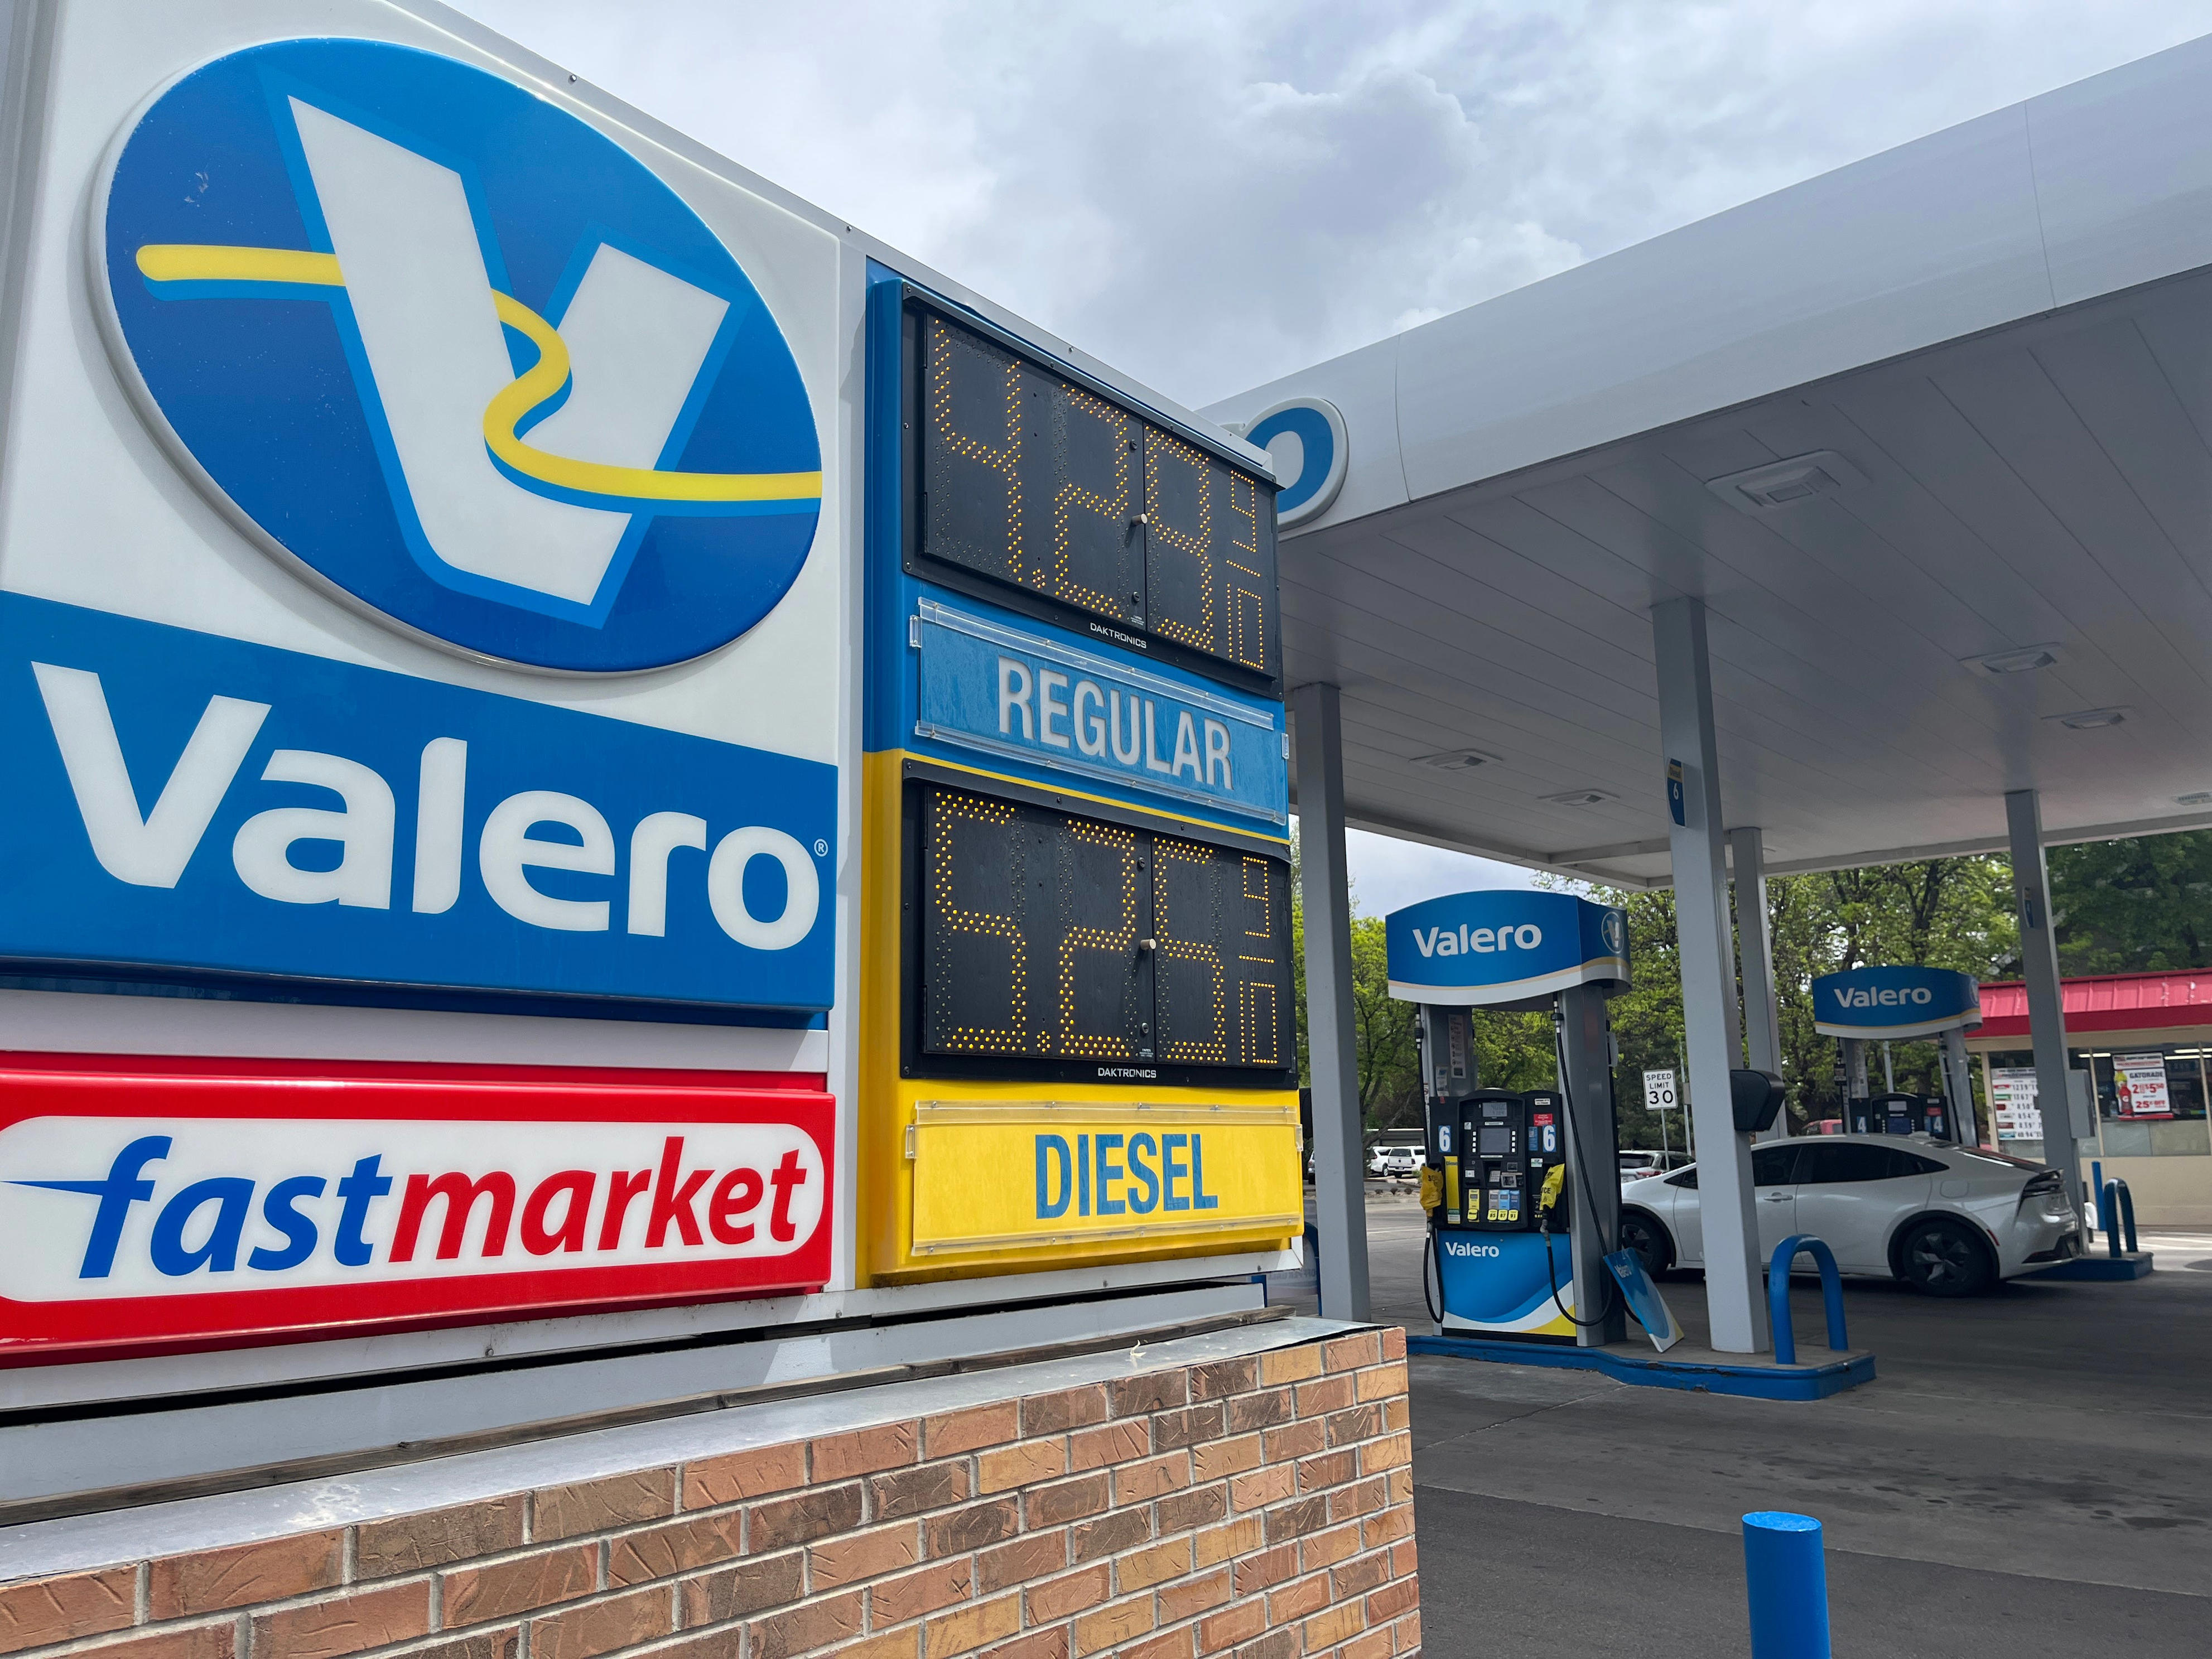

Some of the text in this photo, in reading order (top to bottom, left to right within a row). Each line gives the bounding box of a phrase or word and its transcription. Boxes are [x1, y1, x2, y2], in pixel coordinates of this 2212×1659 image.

[1090, 622, 1147, 649] DAKTRONICS
[998, 655, 1233, 790] REGULAR
[1412, 924, 1542, 958] Valero
[1834, 986, 1932, 1008] Valero
[1098, 1068, 1156, 1078] DAKTRONICS
[1649, 1090, 1673, 1104] 30
[1858, 1117, 1866, 1133] 4
[1933, 1116, 1943, 1132] 4
[1439, 1126, 1450, 1152] 6
[1543, 1125, 1555, 1152] 6
[1035, 1132, 1218, 1219] DIESEL
[1445, 1242, 1500, 1257] Valero
